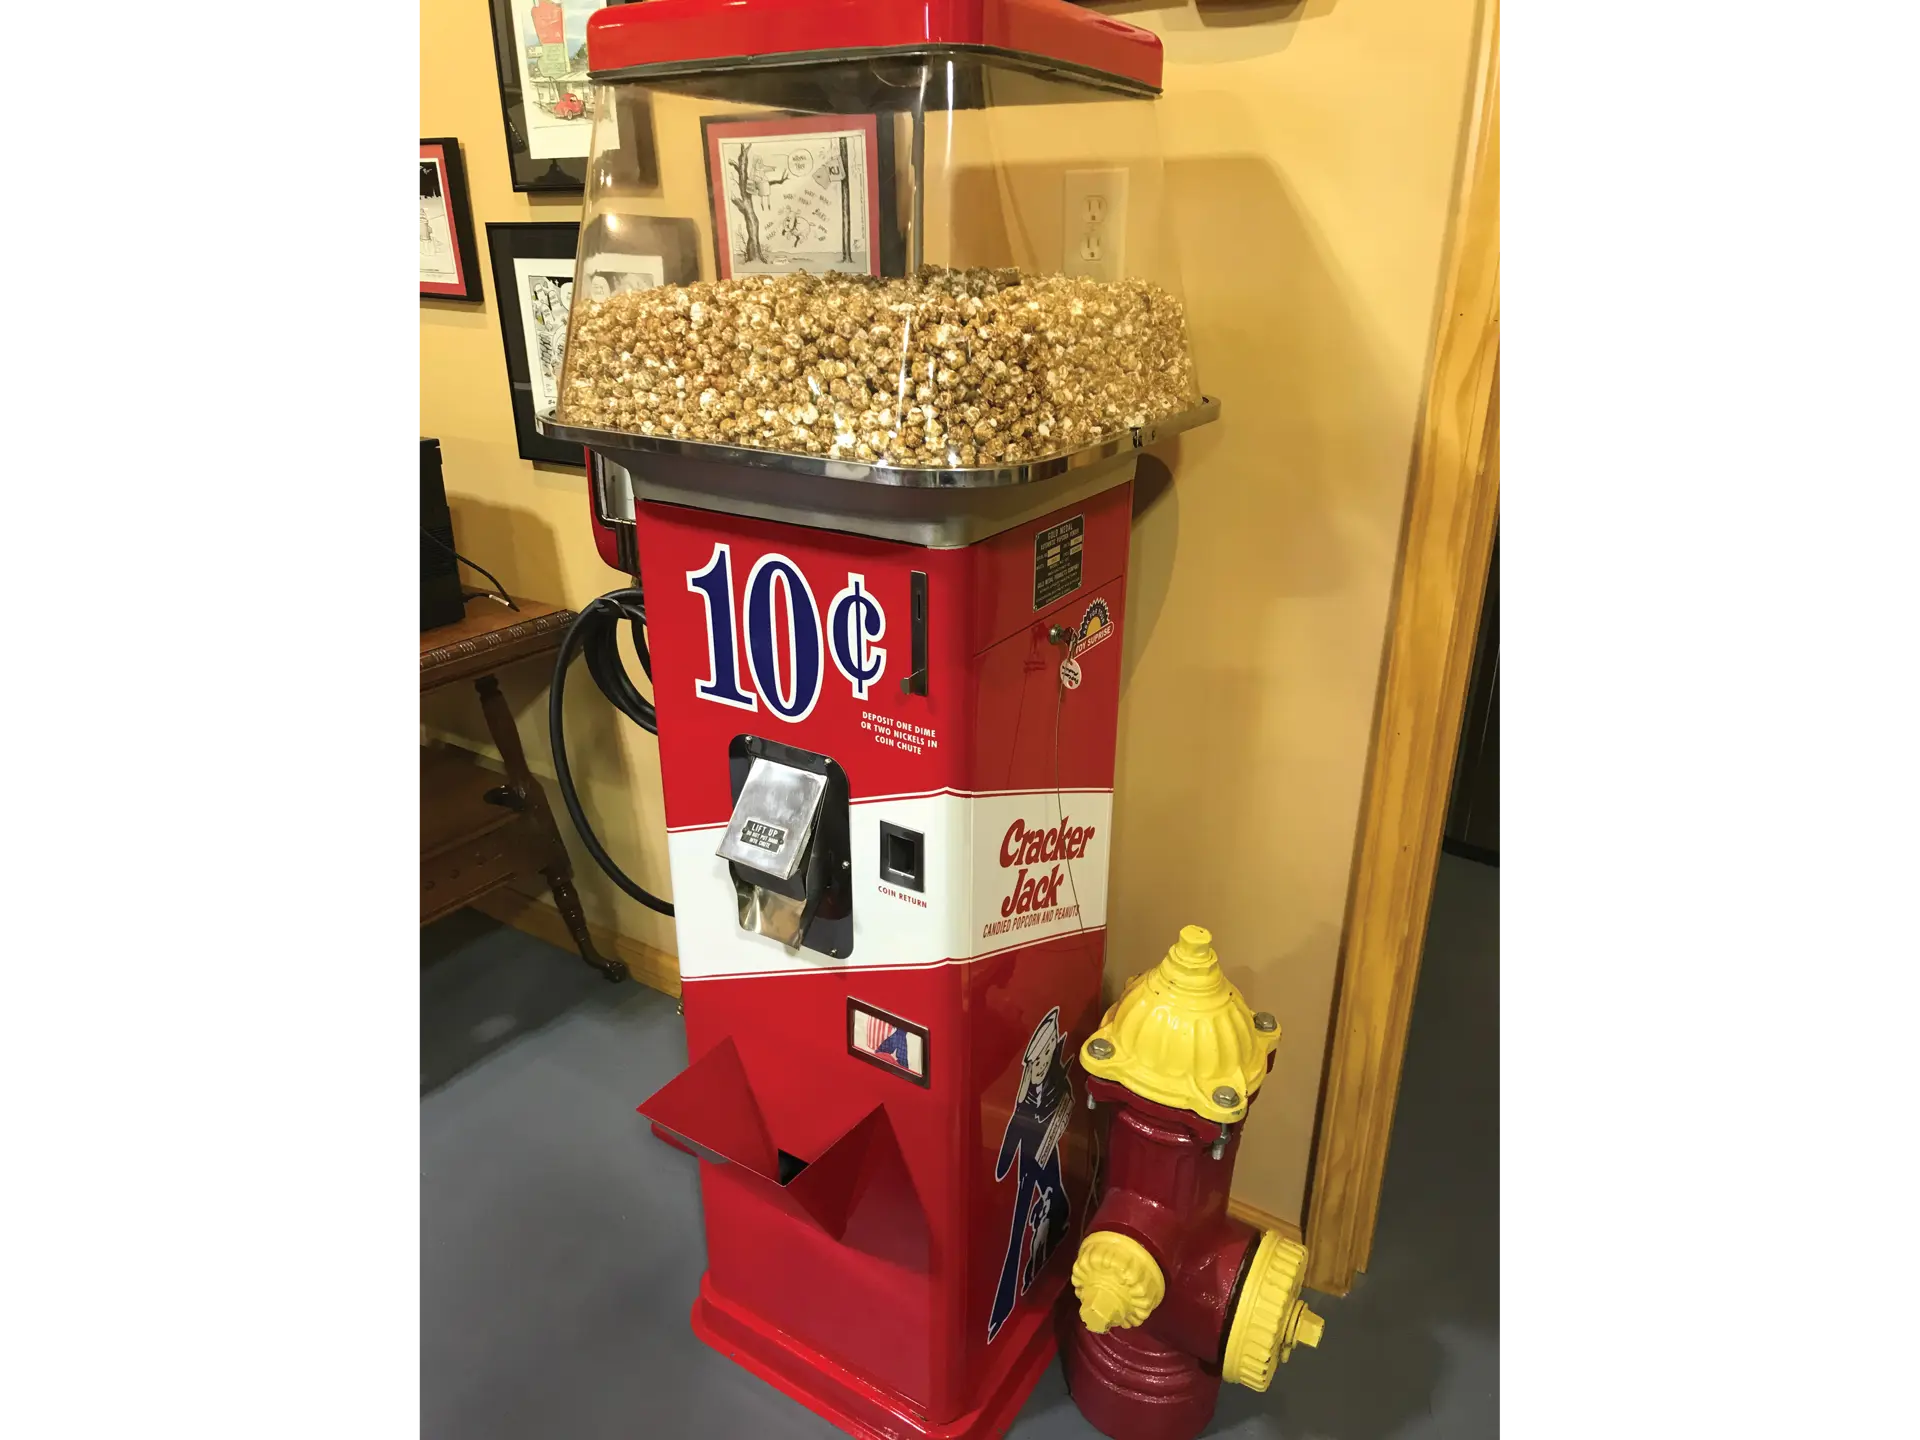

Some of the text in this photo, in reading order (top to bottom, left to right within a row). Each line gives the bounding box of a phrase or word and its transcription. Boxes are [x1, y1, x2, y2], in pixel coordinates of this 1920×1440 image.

[828, 166, 840, 176] KU
[1047, 523, 1073, 540] GOLD MEDAL
[1075, 625, 1112, 654] TOY SUPRISE
[860, 721, 938, 749] OR TWO NICKELS IN
[862, 711, 936, 738] DEPOSIT ONE DIME
[875, 735, 922, 755] COIN CHUTE
[751, 823, 778, 837] LIFT UP
[999, 815, 1096, 868] Cracker
[878, 885, 927, 909] COIN RETURN
[1001, 863, 1065, 918] Jack
[982, 904, 1080, 939] CANDIED POPCORN AND PEANUTS
